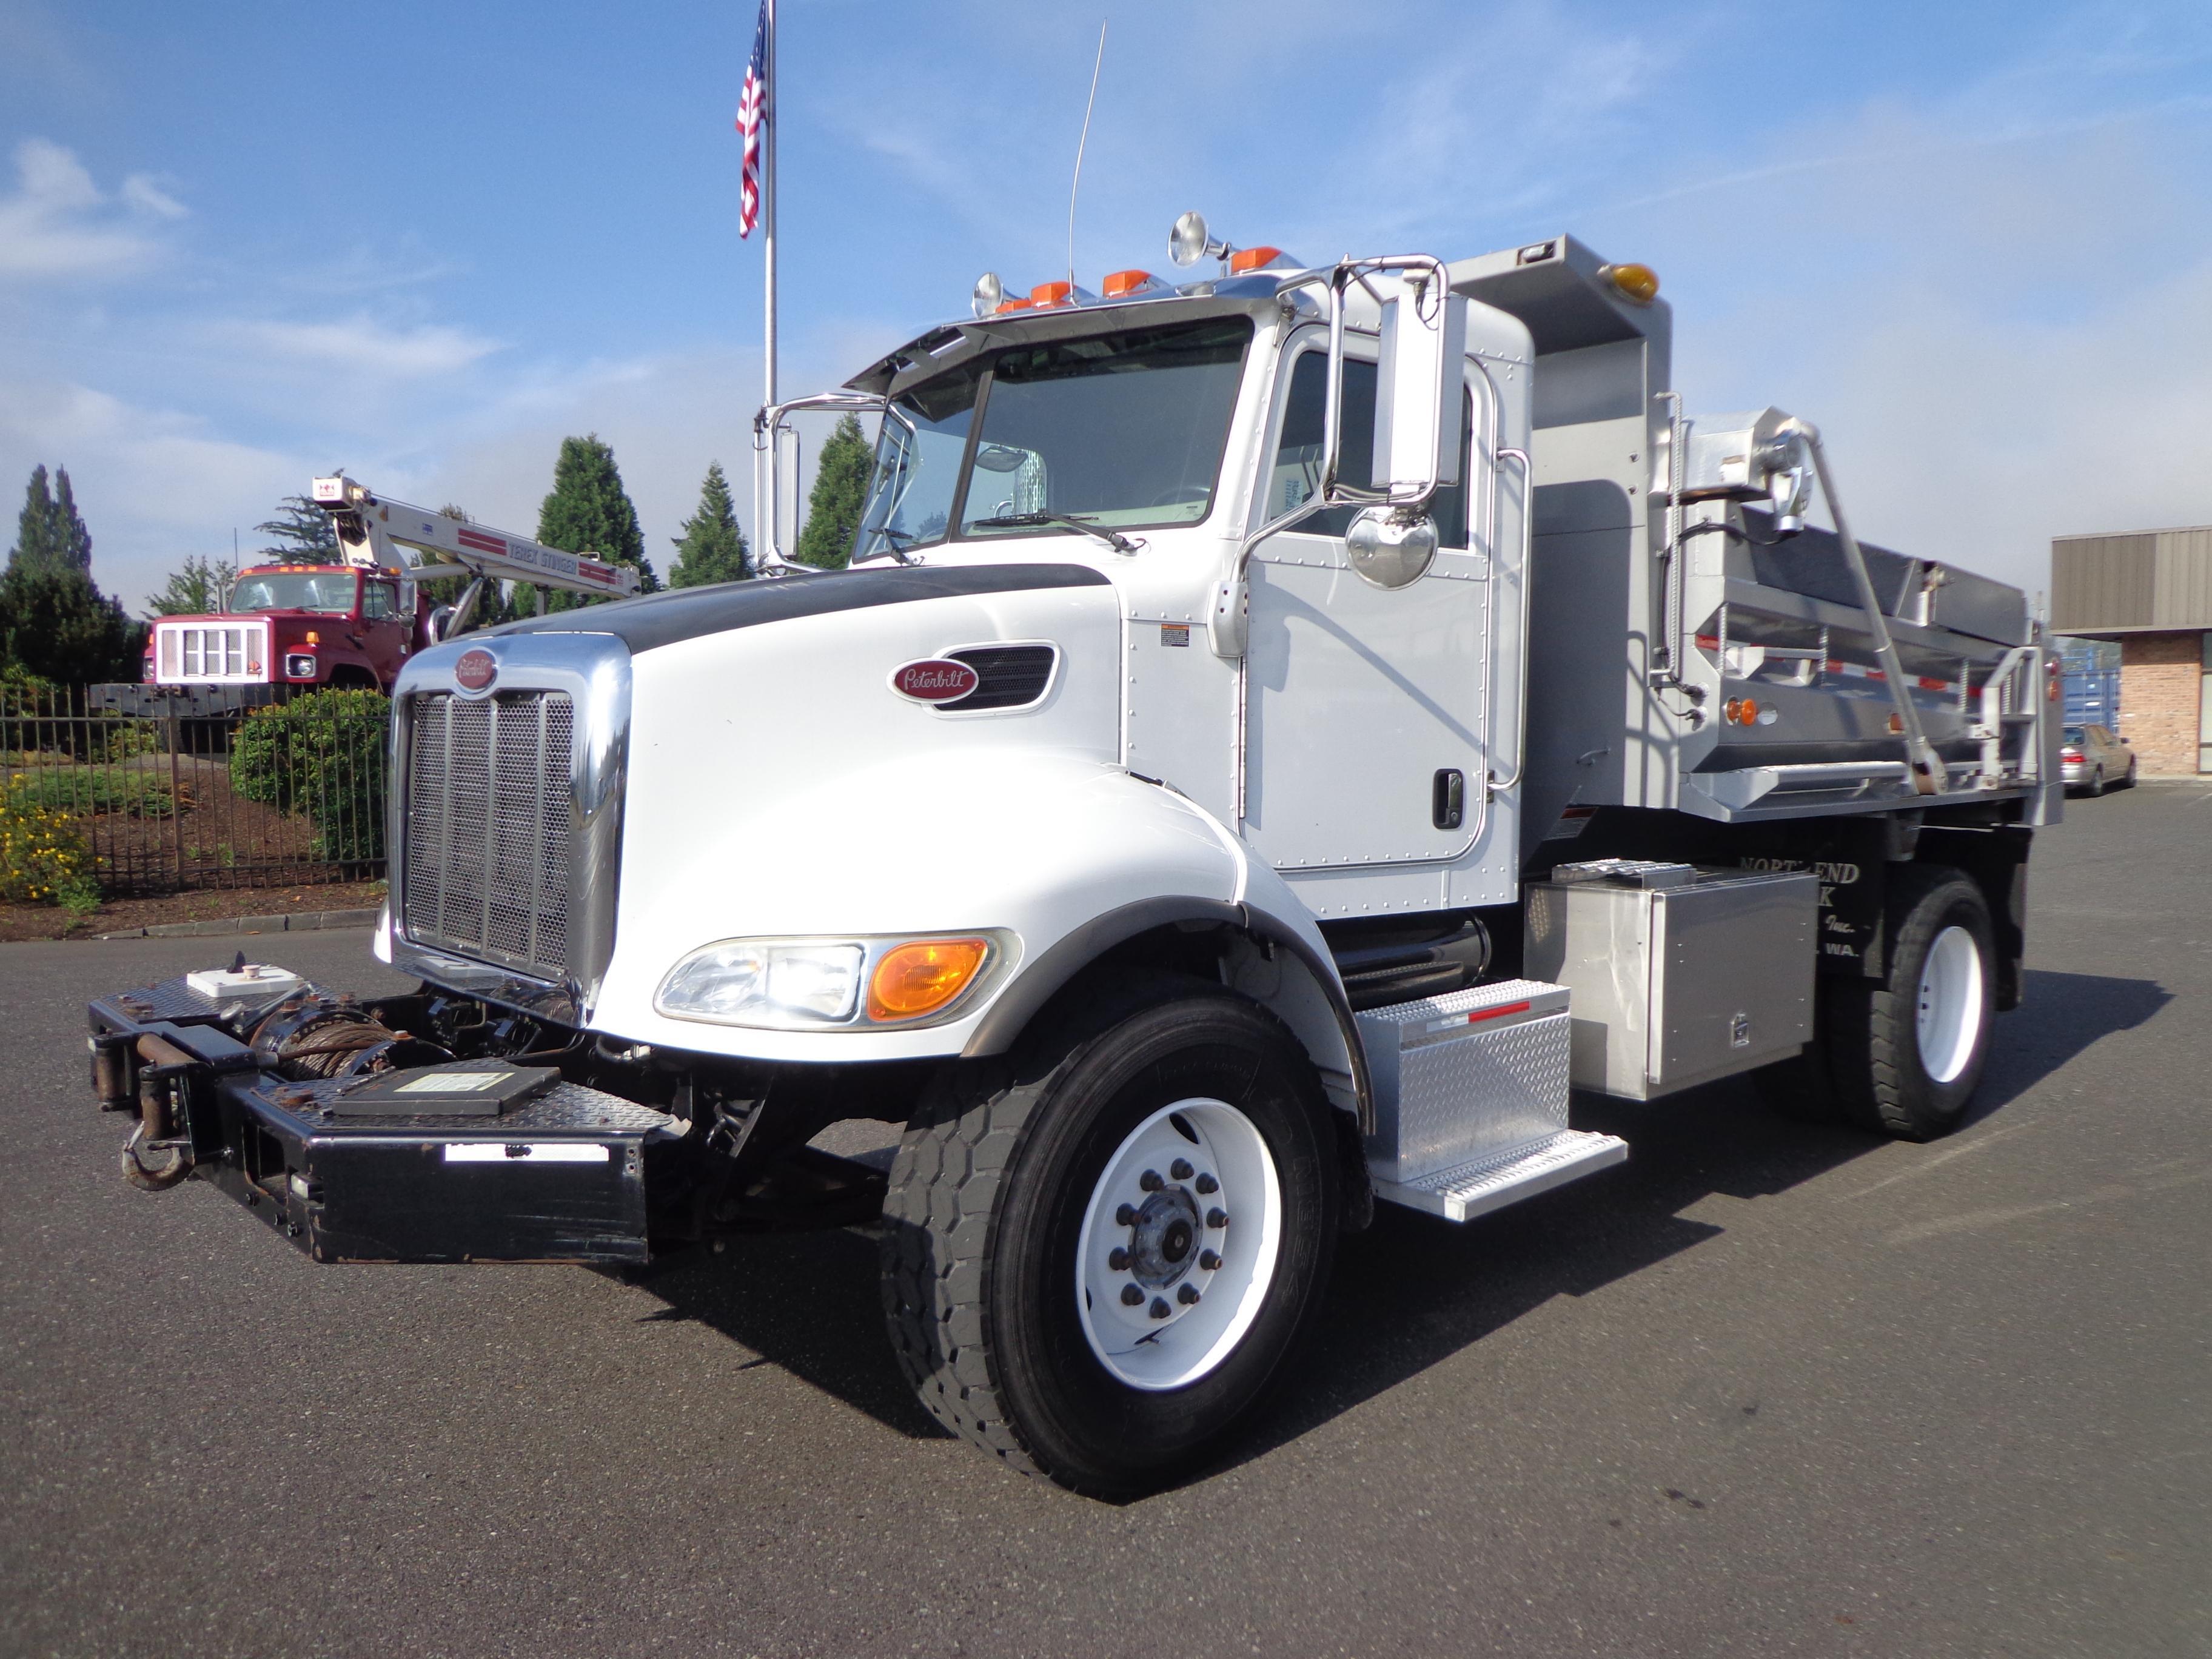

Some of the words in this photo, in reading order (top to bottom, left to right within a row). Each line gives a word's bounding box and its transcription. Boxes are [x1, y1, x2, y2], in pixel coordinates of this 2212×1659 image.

[904, 668, 970, 690] Peterbilt
[1740, 857, 1809, 873] NORT
[1815, 862, 1860, 884] END
[1825, 942, 1860, 957] WA.
